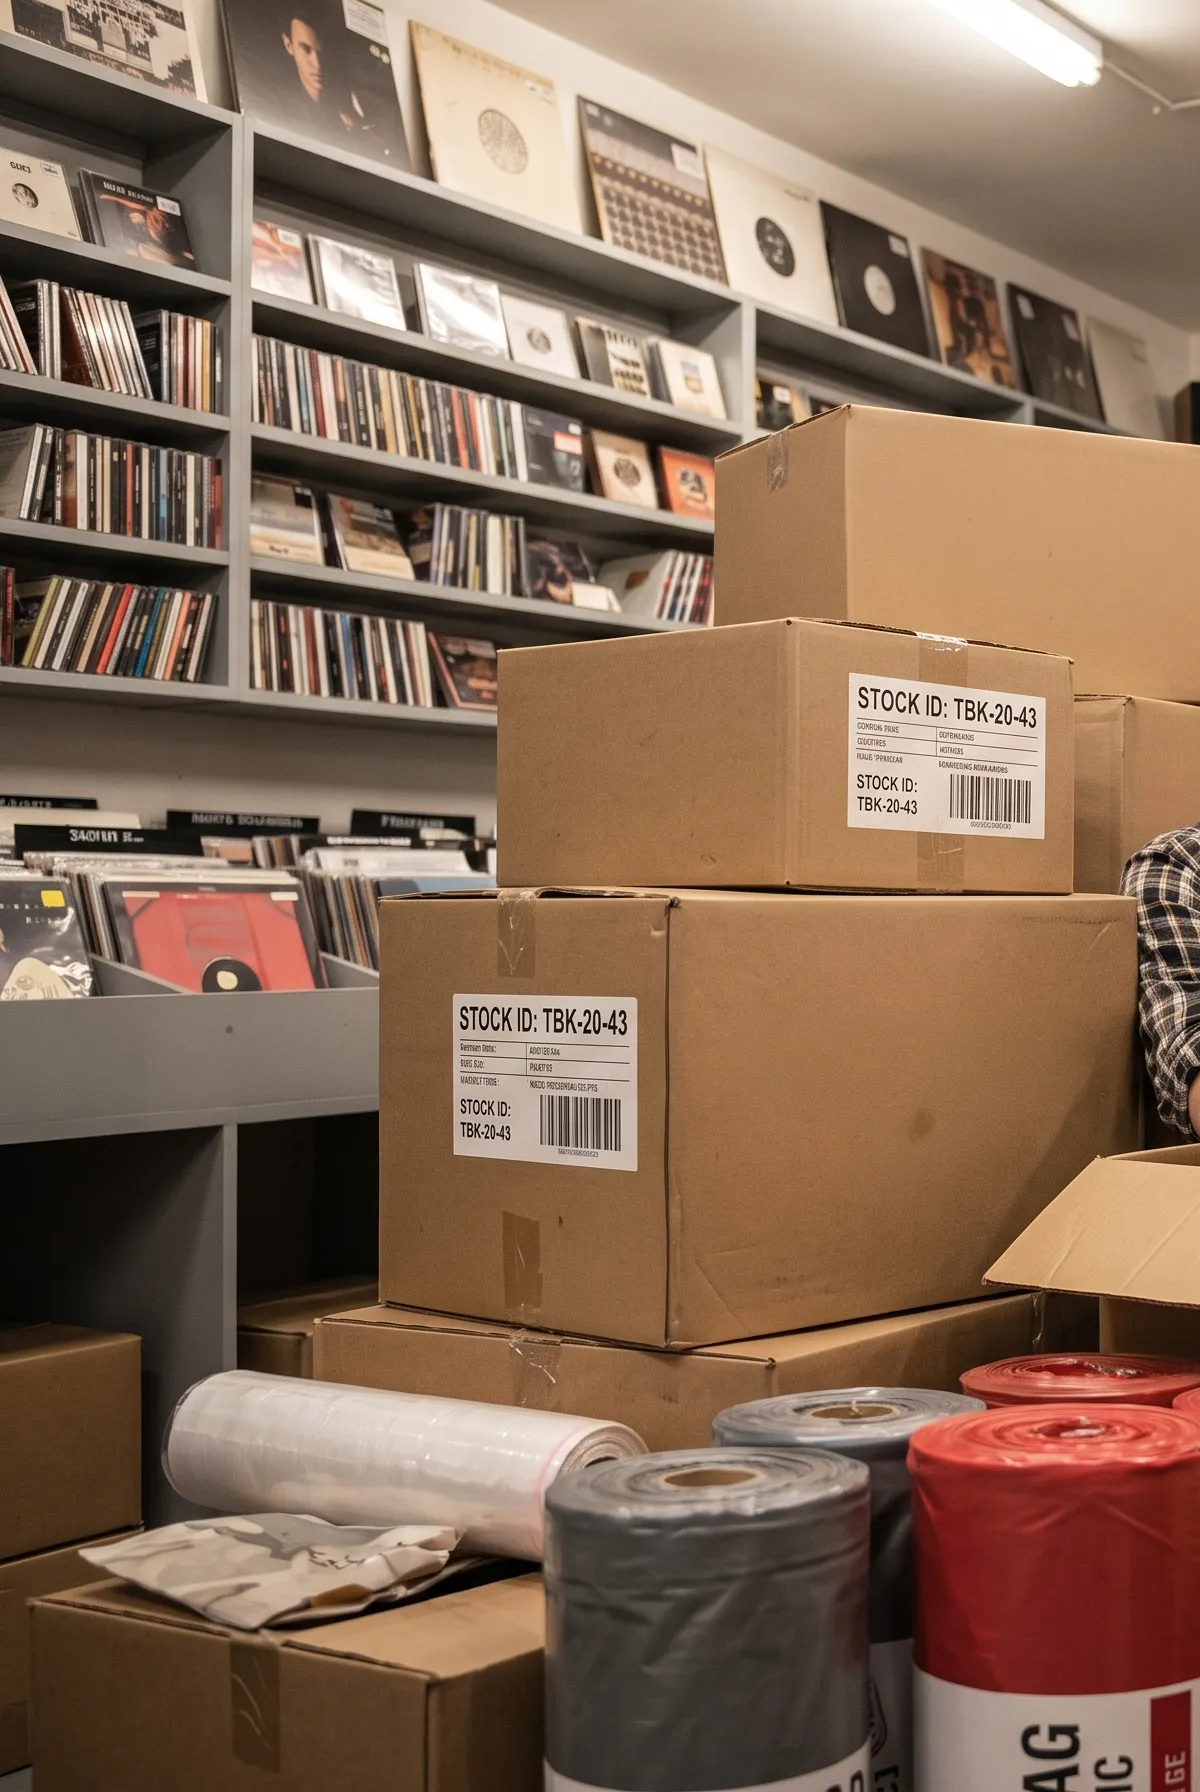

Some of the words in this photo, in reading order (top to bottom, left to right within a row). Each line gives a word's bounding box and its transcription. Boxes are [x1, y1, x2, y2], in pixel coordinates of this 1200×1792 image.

[857, 686, 920, 716] STOCK
[925, 694, 948, 719] ID:
[953, 697, 1037, 729] TBK-20-43
[856, 773, 899, 792] STOCK
[901, 777, 918, 793] ID:
[856, 796, 918, 815] TBK-20-43
[459, 1005, 513, 1032] STOCK
[517, 1007, 538, 1033] ID:
[542, 1007, 628, 1036] TBK-20-43
[460, 1098, 495, 1117] STOCK
[497, 1100, 511, 1117] ID:
[460, 1121, 511, 1141] TBK-20-43
